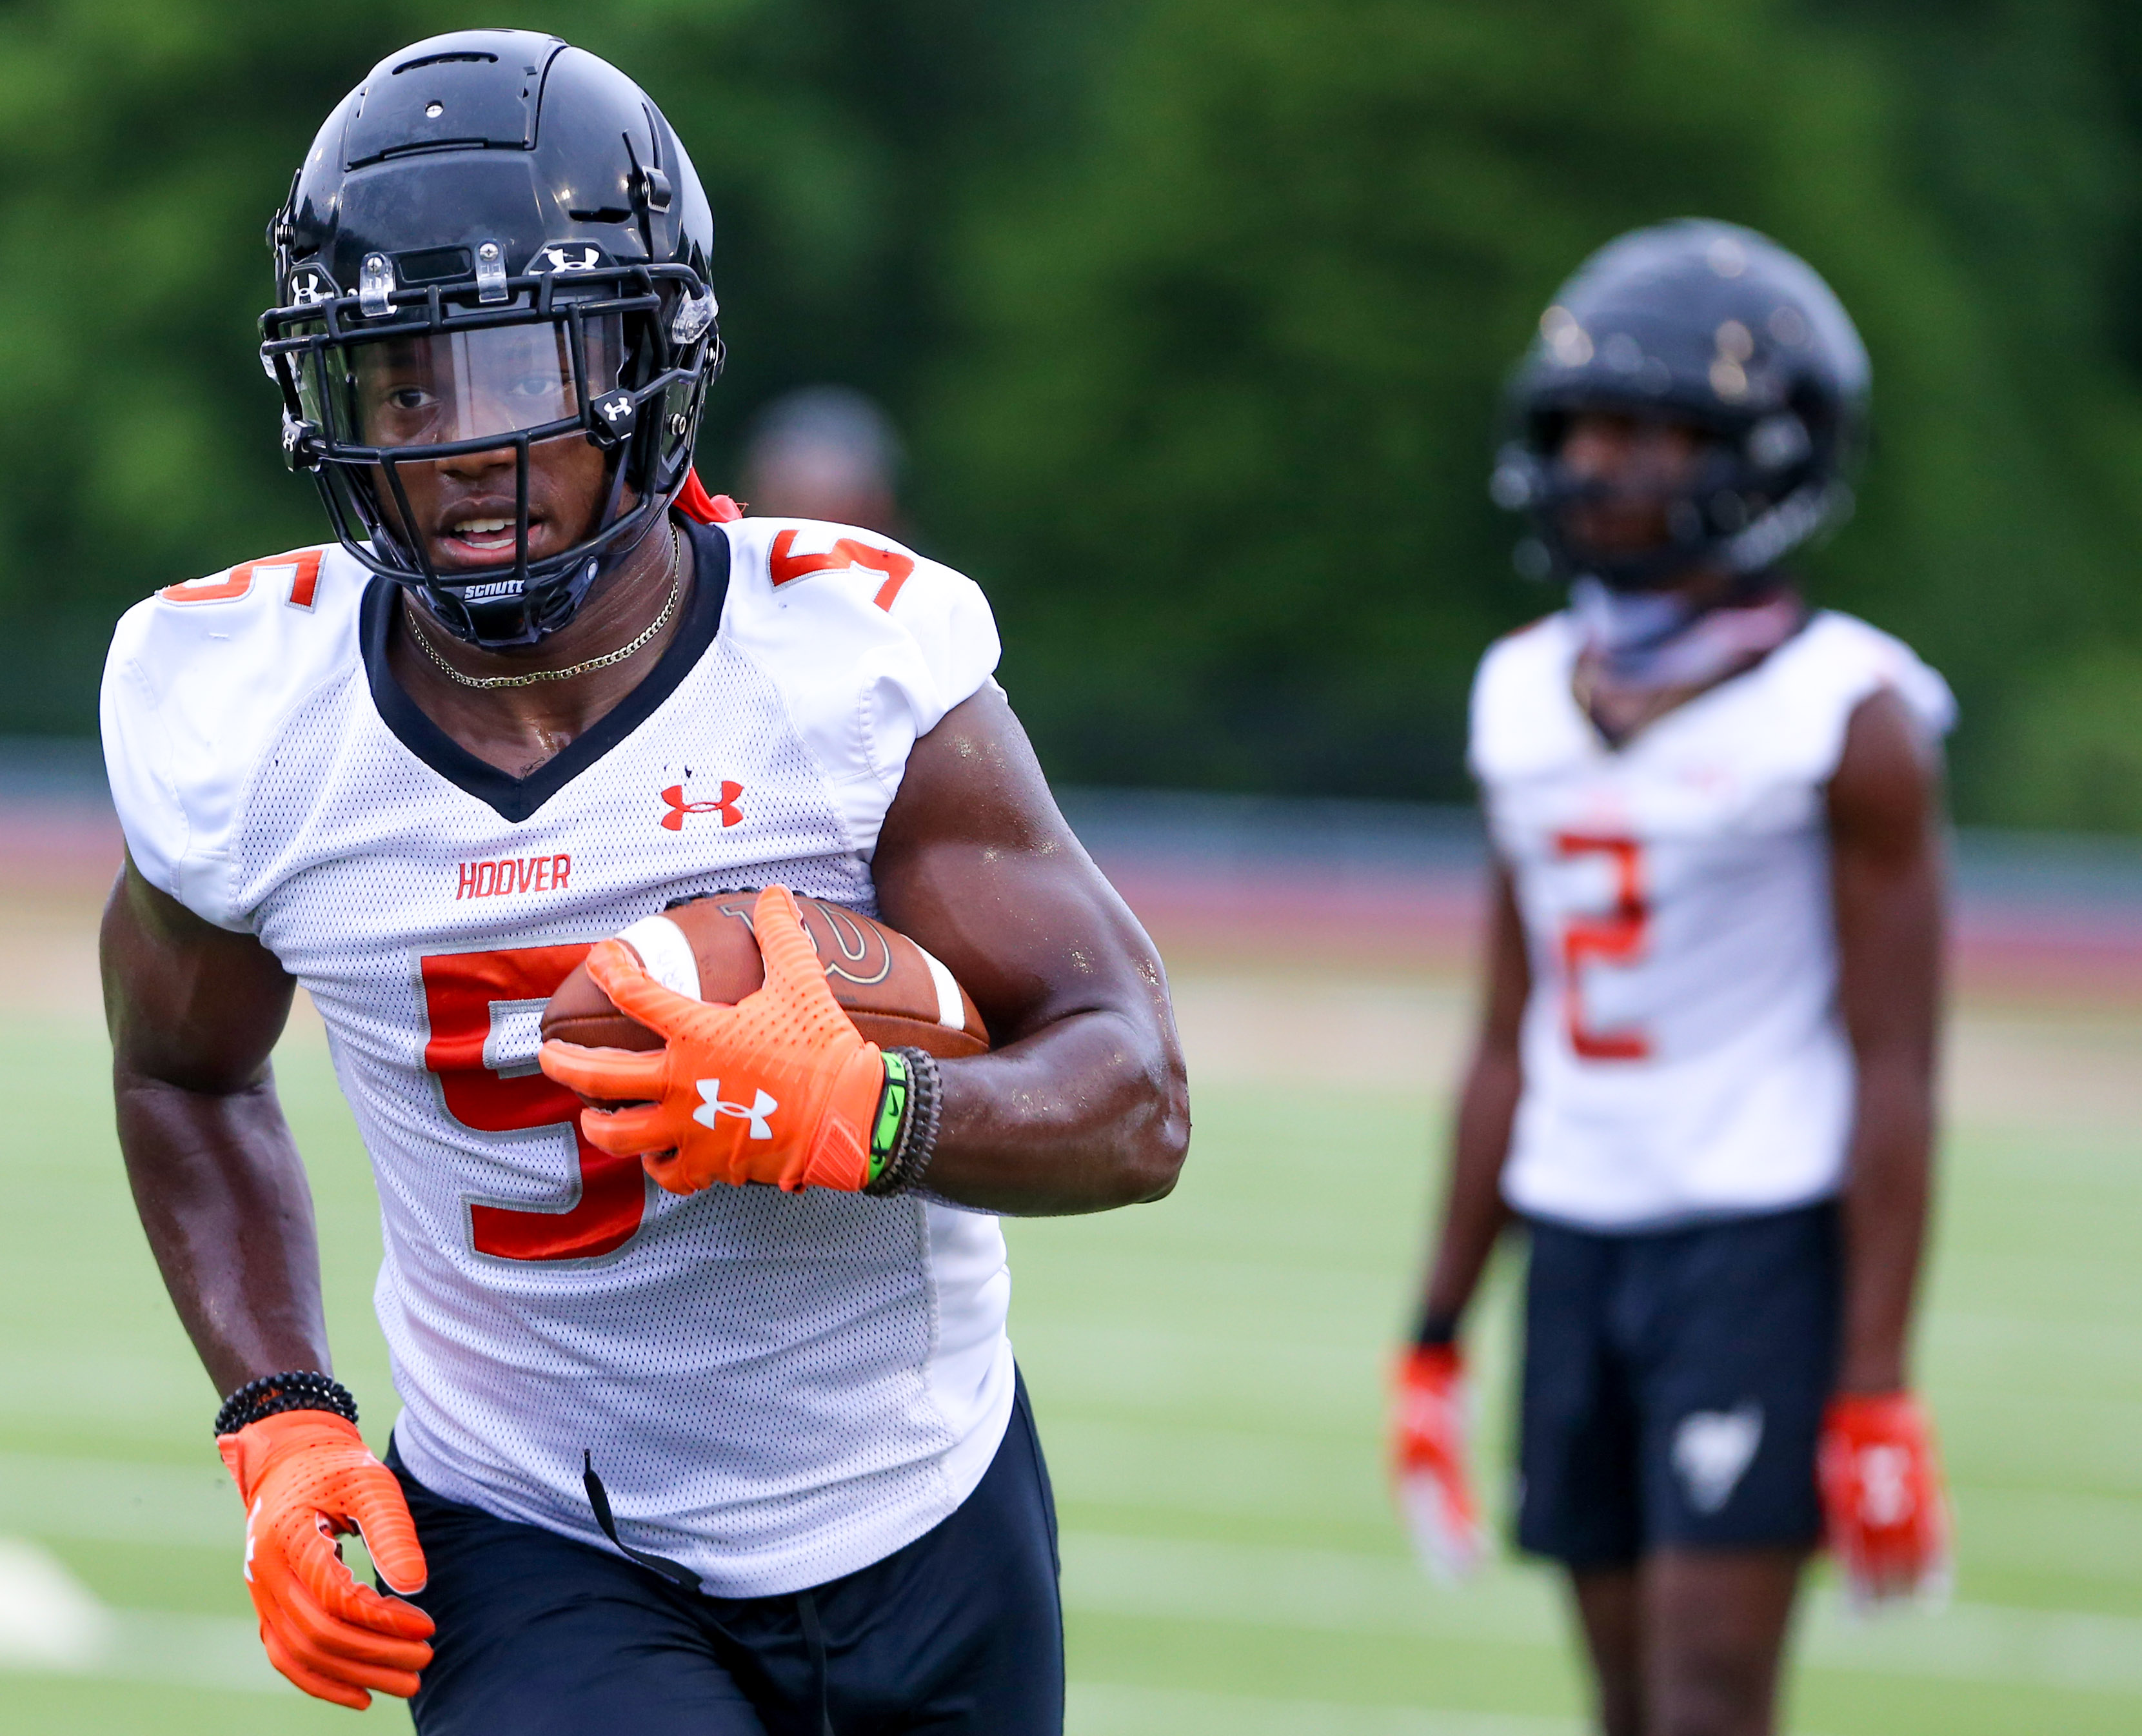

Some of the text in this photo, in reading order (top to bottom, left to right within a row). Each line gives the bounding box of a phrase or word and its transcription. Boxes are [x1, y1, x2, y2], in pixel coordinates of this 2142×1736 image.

[456, 853, 571, 900] HOOVER
[1550, 831, 1658, 1064] 2
[409, 929, 659, 1271] 5
